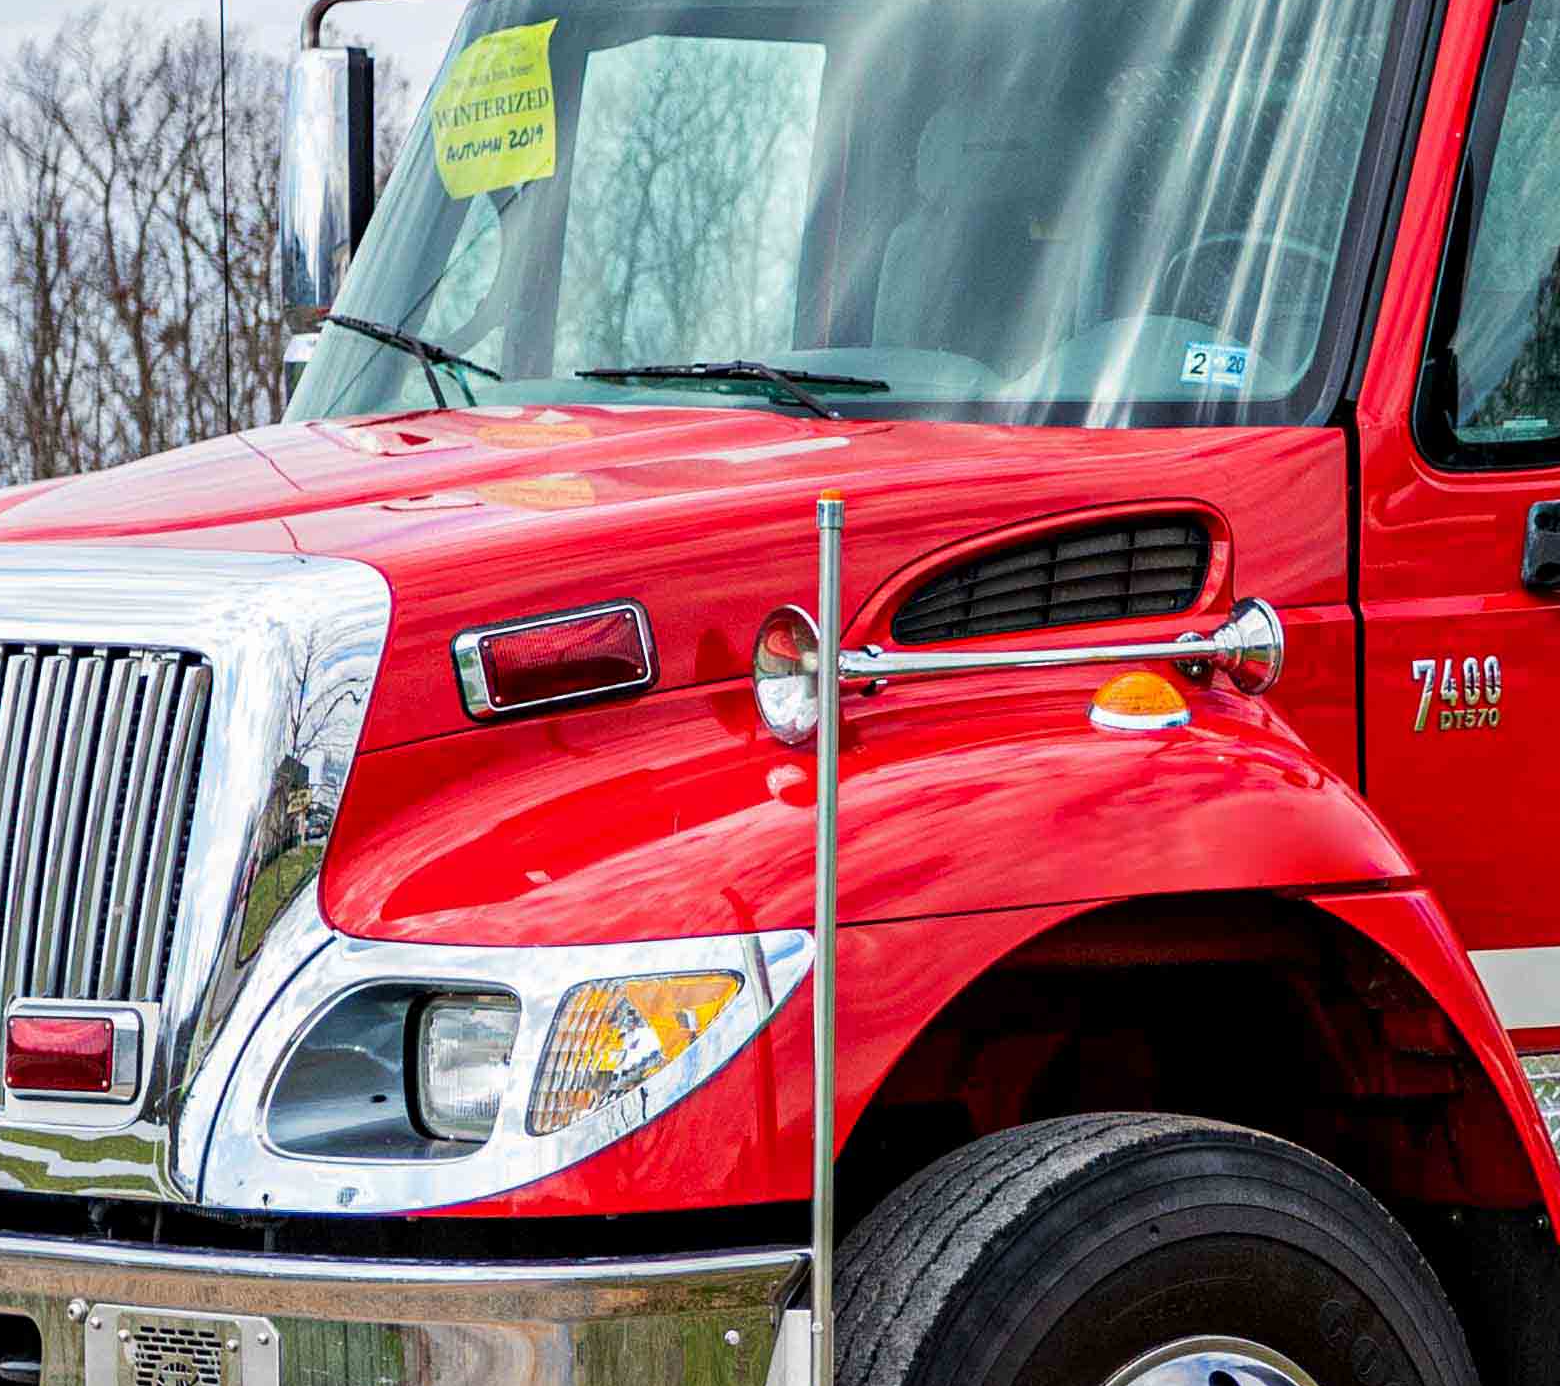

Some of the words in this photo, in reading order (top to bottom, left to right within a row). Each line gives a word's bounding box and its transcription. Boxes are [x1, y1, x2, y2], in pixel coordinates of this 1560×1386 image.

[434, 86, 550, 130] WINTERIZED
[445, 135, 503, 164] AUTUMN
[508, 123, 545, 150] 2019
[1190, 352, 1207, 375] 2
[1225, 355, 1246, 374] 20
[1411, 655, 1503, 733] 7400
[1439, 707, 1501, 731] DT570
